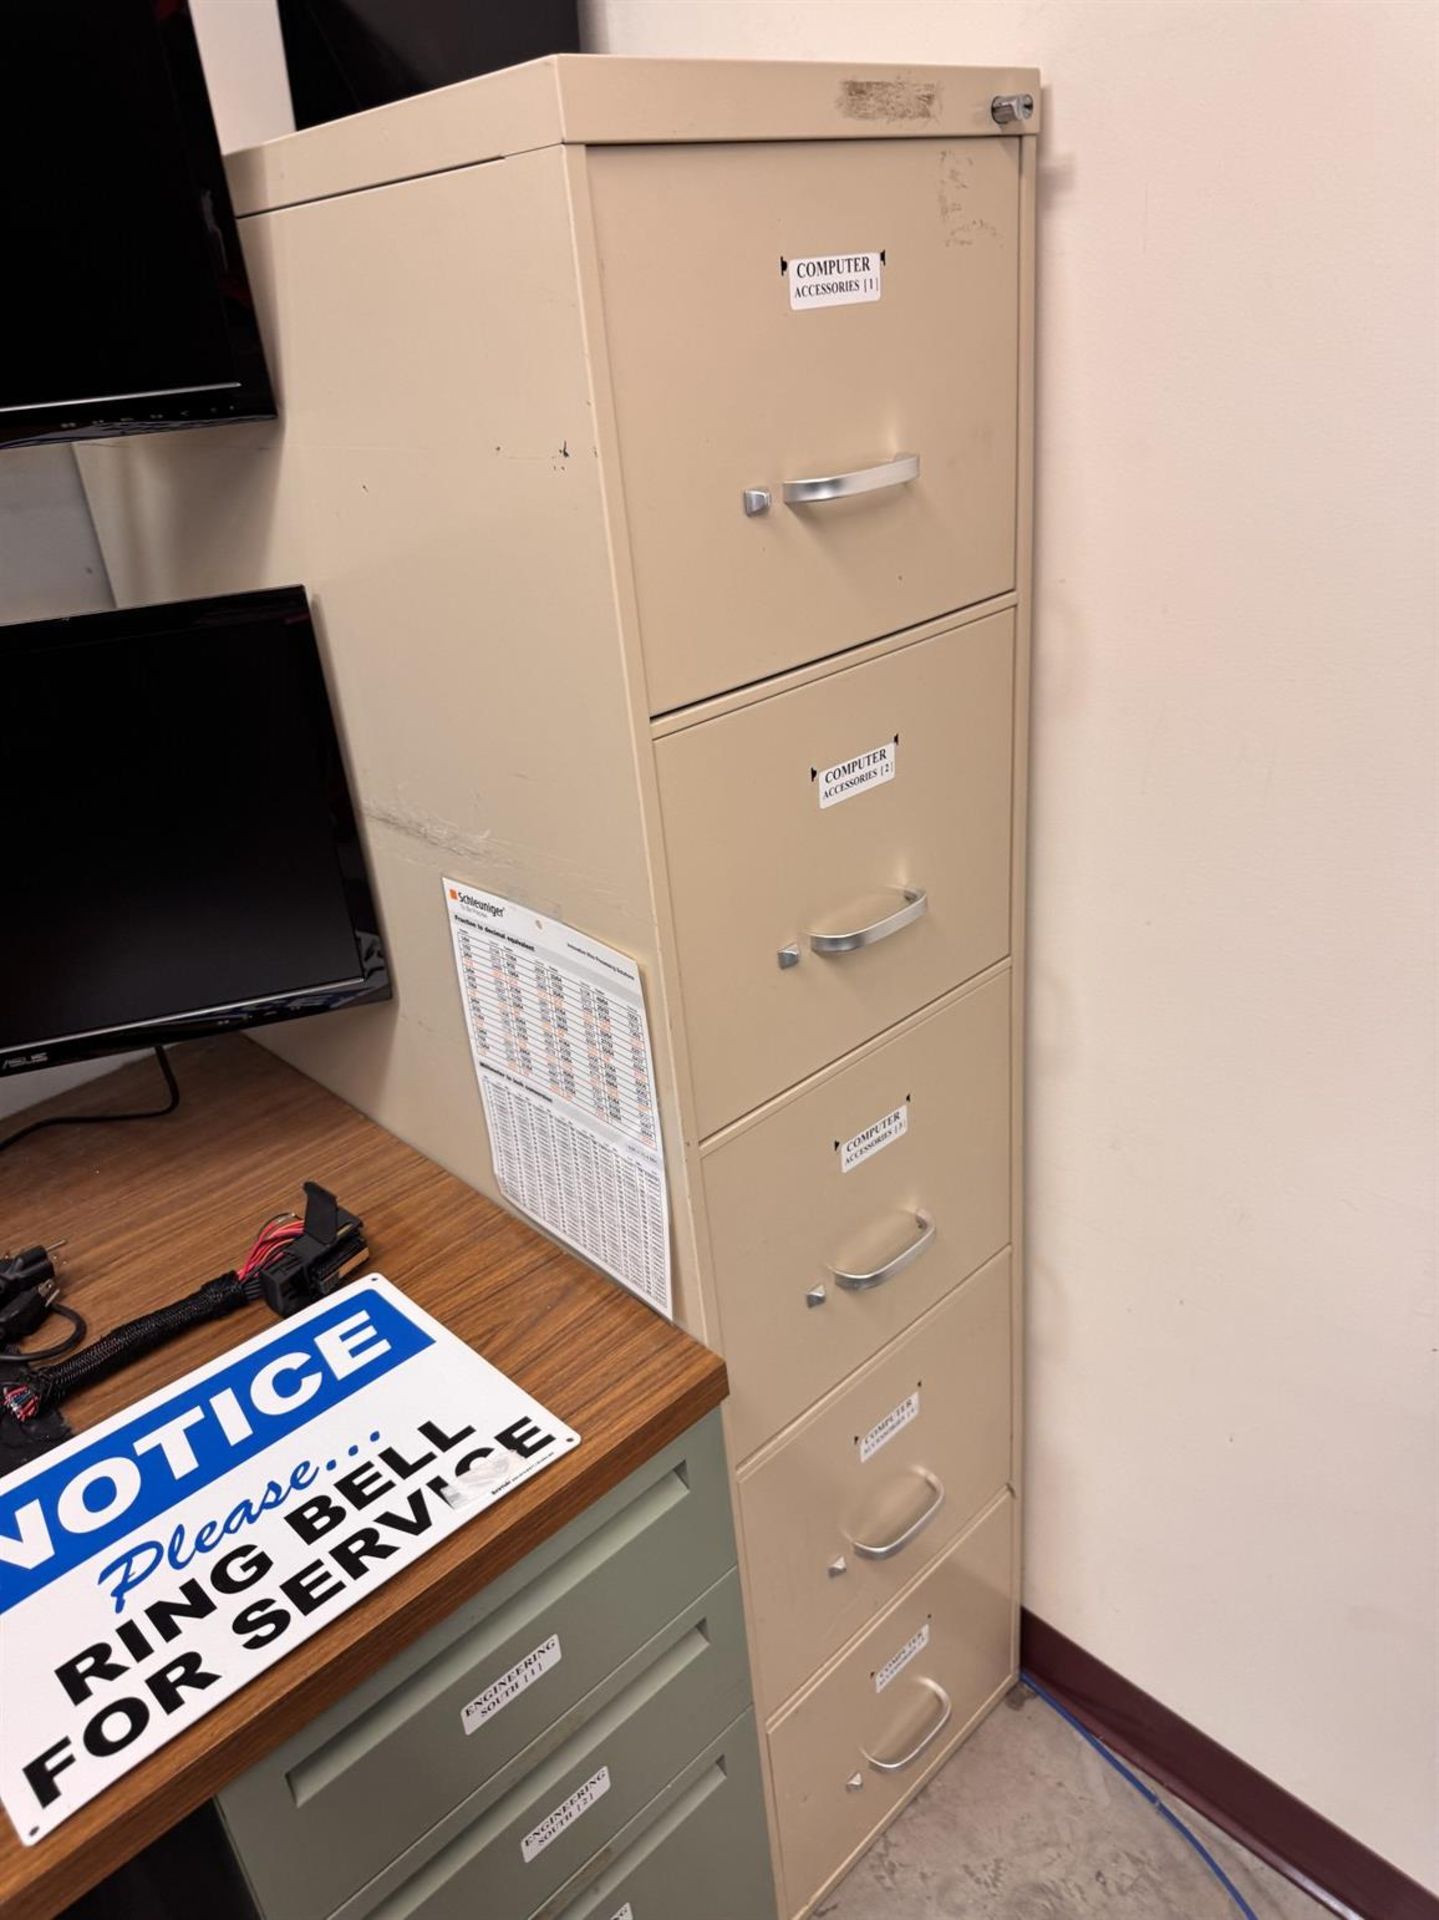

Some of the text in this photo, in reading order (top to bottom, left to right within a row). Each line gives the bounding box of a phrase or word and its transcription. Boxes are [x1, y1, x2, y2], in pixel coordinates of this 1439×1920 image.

[796, 256, 871, 278] COMPUTER
[795, 280, 860, 298] ACCESSORIES
[823, 769, 878, 798] ACCESSORIES
[824, 748, 887, 784] COMPUTER
[2, 1052, 48, 1070] ASUS
[846, 1111, 901, 1152] COMPUTER
[55, 1420, 476, 1705] RING BELL
[466, 1639, 555, 1716] ENGINEERING
[480, 1682, 519, 1717] SOUTH
[23, 1652, 221, 1808] FOR
[525, 1770, 606, 1846] ENGINEERING
[539, 1811, 572, 1846] SOUTH
